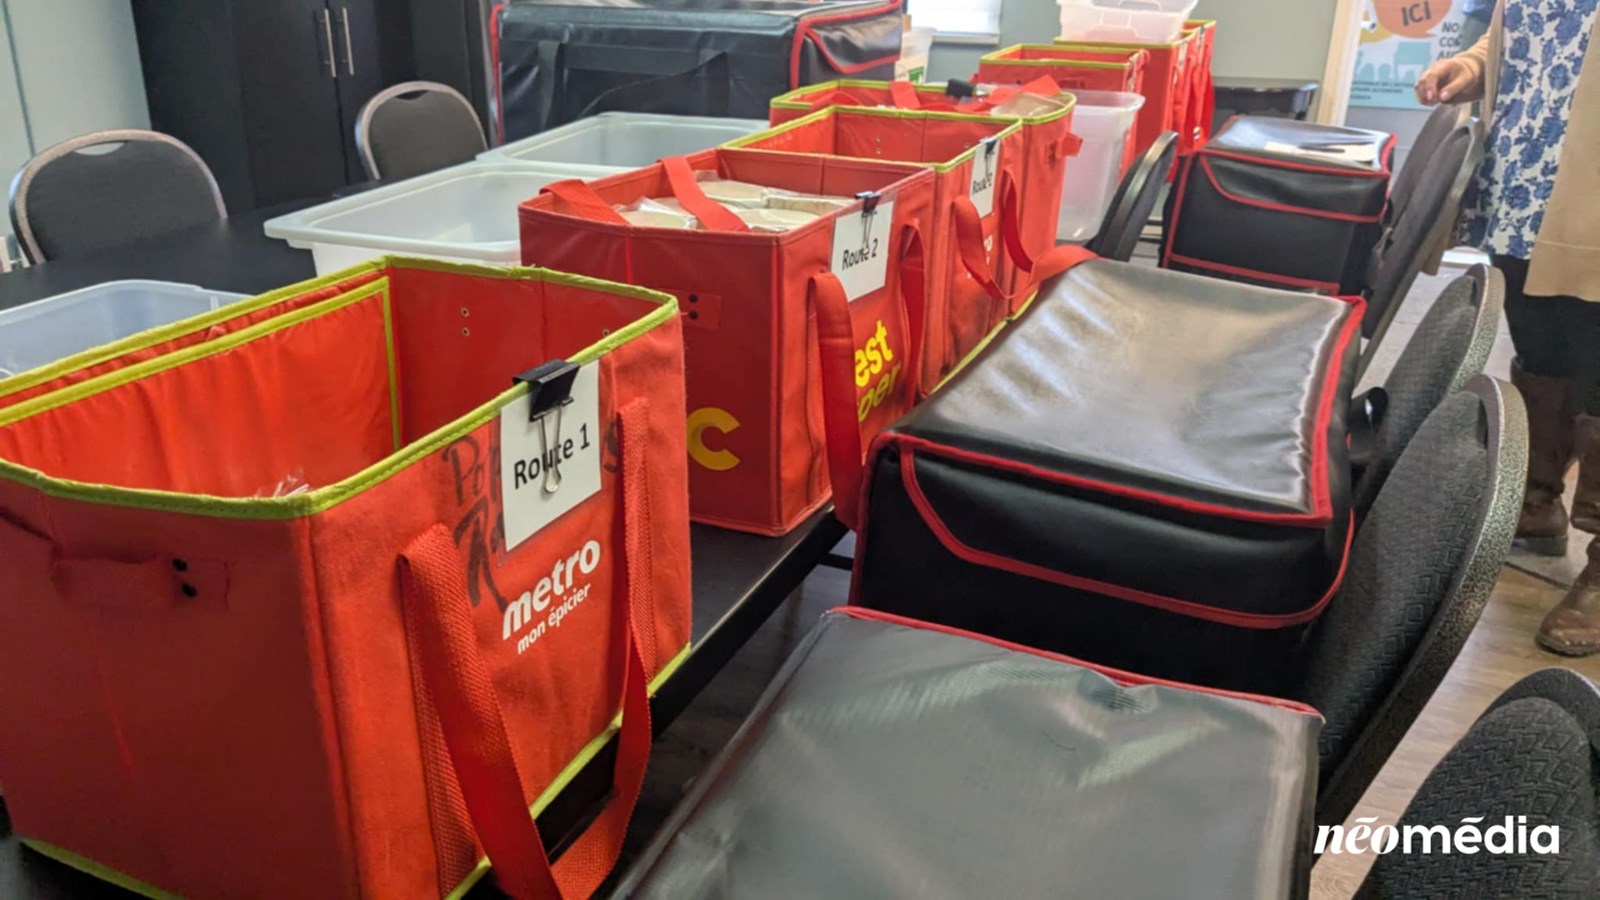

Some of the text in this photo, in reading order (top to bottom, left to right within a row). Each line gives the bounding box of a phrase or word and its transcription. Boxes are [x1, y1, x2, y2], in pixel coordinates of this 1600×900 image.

[1401, 1, 1431, 26] ICI
[1441, 22, 1460, 33] NO
[842, 238, 879, 271] Route 2
[855, 320, 893, 388] est
[858, 360, 902, 422] per
[514, 438, 573, 489] Route
[579, 423, 590, 451] 1
[503, 540, 600, 640] metro
[517, 583, 590, 655] mon épicier
